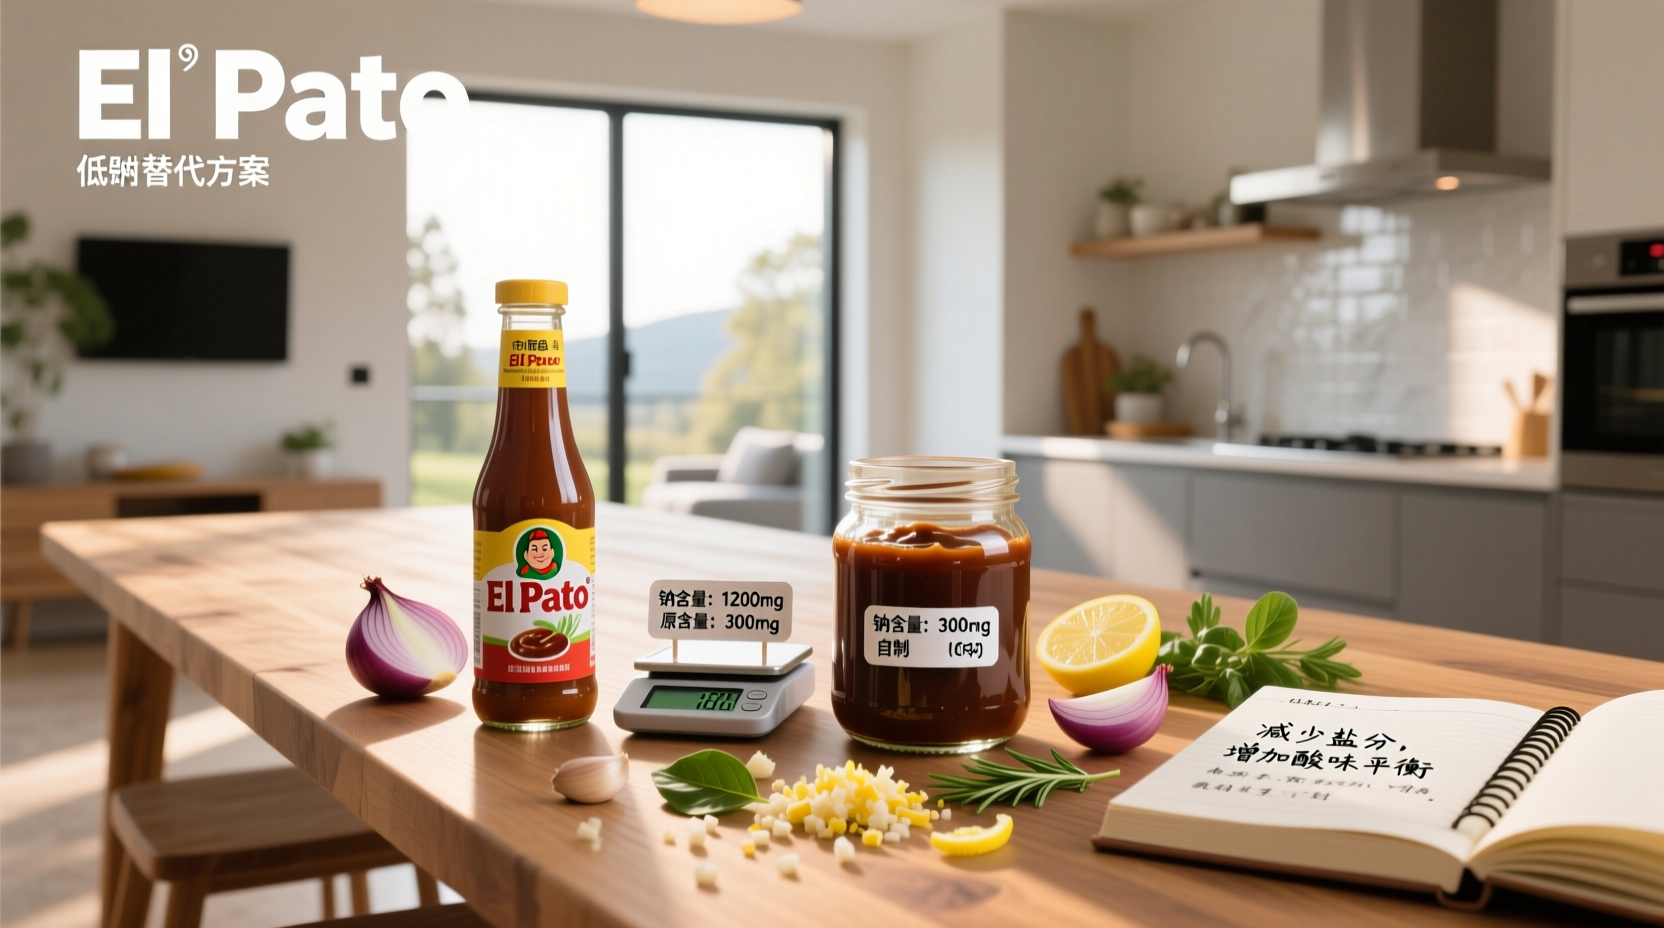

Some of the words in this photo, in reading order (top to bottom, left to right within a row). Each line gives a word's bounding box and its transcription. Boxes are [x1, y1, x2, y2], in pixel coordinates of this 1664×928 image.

[487, 580, 514, 613] El
[519, 580, 589, 613] Pato
[721, 591, 784, 612] 1200mg
[725, 614, 780, 635] 300mg
[878, 638, 910, 658] 自制
[1223, 742, 1434, 779] 增加酸味平衡
